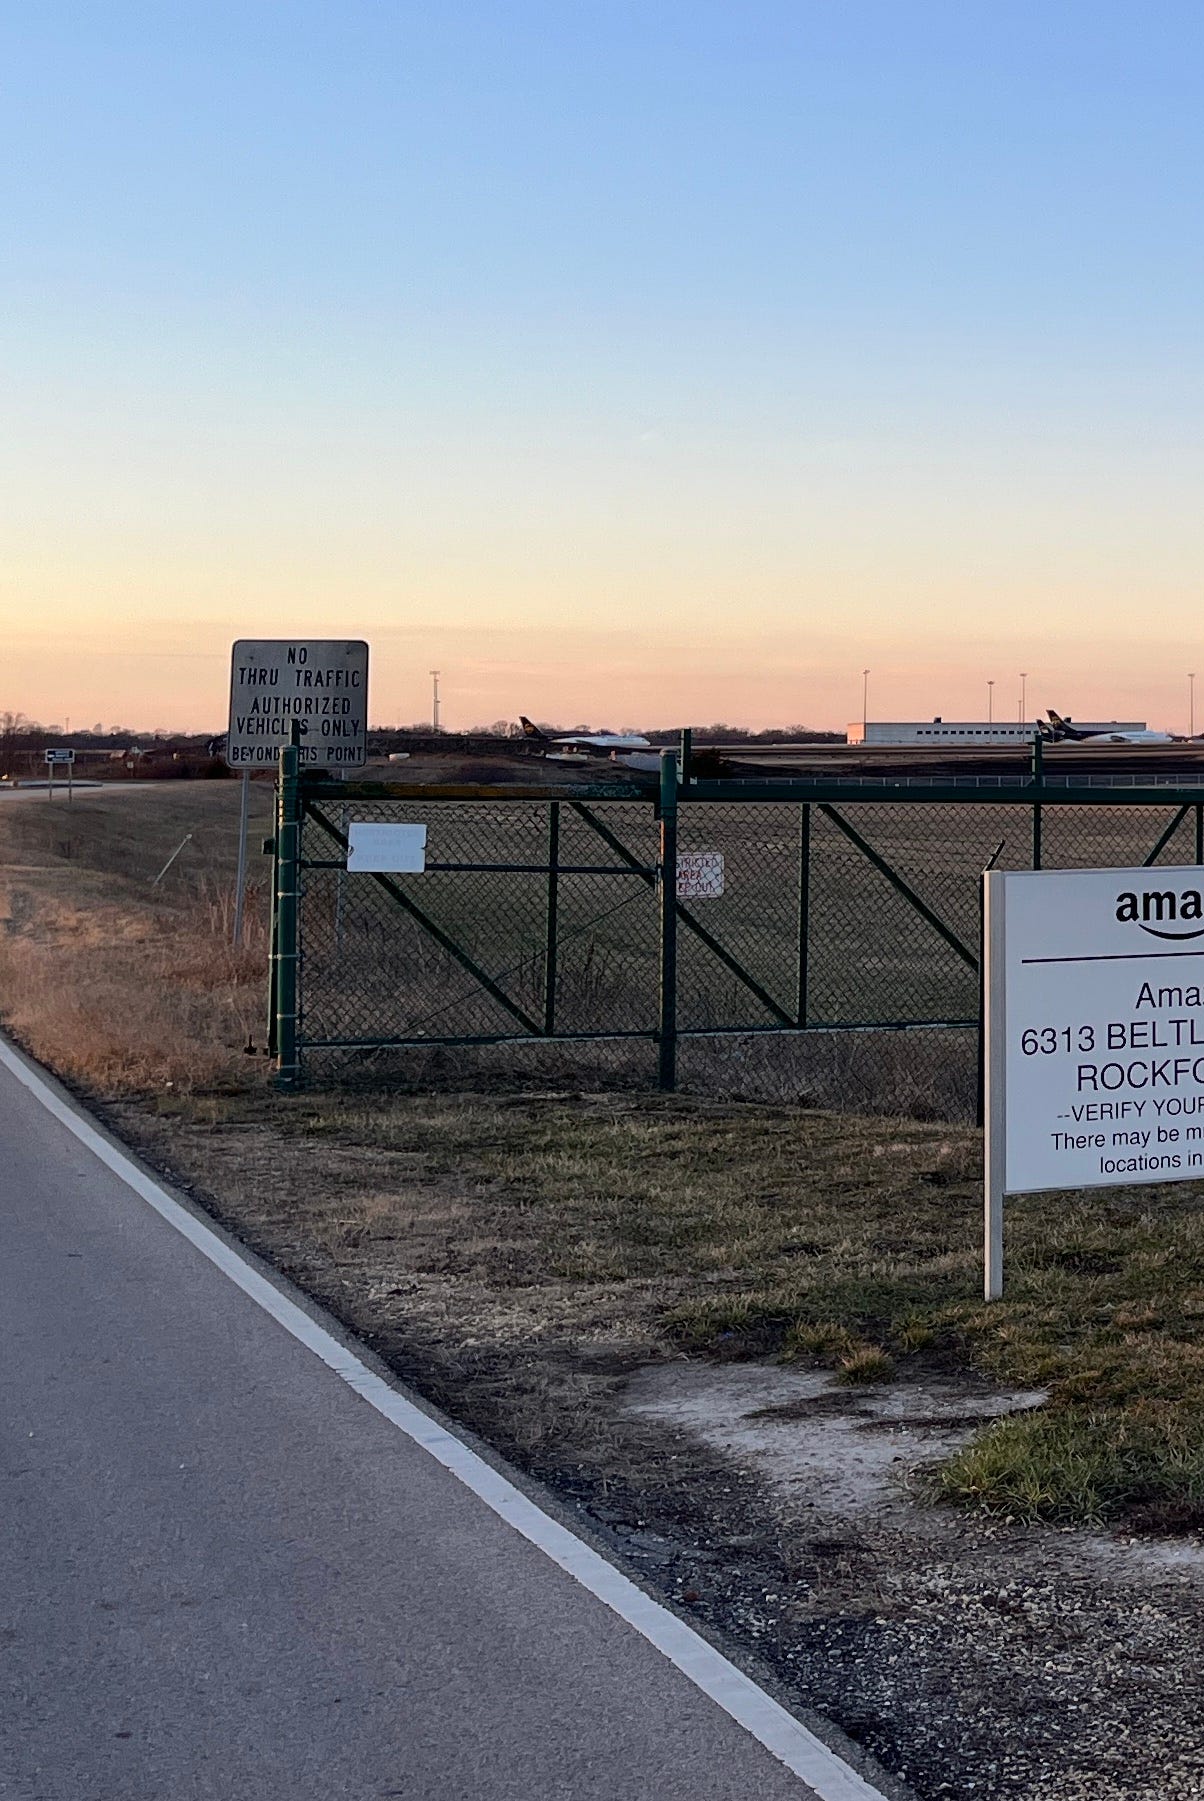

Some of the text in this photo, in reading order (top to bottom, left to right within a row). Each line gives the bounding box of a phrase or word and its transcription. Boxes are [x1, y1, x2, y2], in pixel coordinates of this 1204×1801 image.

[287, 647, 308, 665] NO
[238, 667, 360, 688] THRU TRAFFIC
[250, 697, 351, 715] AUTHORIZED
[236, 717, 360, 737] VEHICLS ONLY
[232, 746, 363, 761] BEYOND HIS POINT
[1021, 1025, 1096, 1056] 6313
[1051, 1130, 1106, 1151] There
[1112, 1129, 1151, 1149] may
[1157, 1123, 1180, 1143] be
[1099, 1153, 1182, 1175] locations
[1186, 1150, 1203, 1167] in
